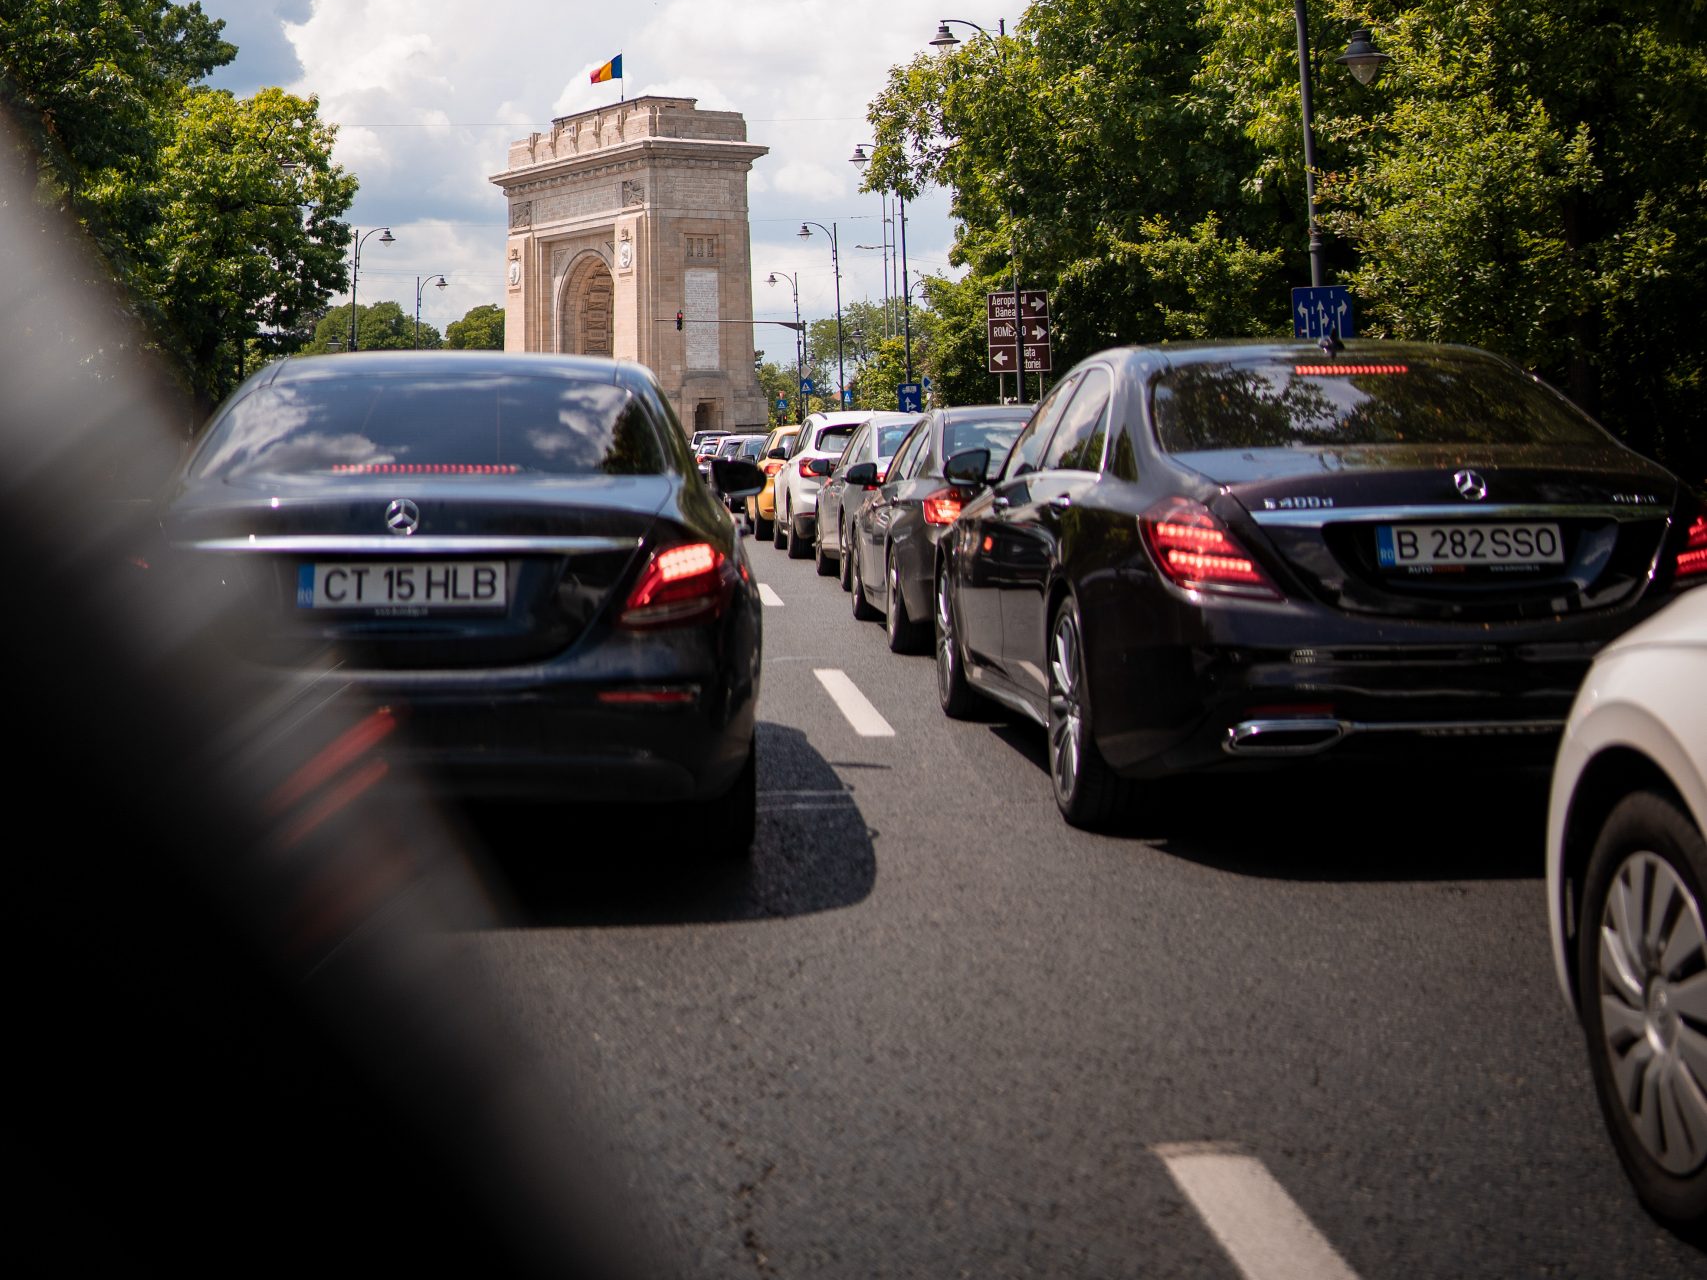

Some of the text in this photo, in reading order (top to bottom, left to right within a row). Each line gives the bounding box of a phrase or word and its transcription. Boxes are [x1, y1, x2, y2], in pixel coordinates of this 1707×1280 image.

[992, 294, 1027, 307] Aeropoul
[994, 325, 1026, 337] ROMEO
[1023, 346, 1036, 359] iața
[1396, 527, 1557, 560] B 282 SSO
[1380, 549, 1394, 561] RO
[324, 566, 497, 601] CT 15 HLB
[297, 588, 312, 603] RO
